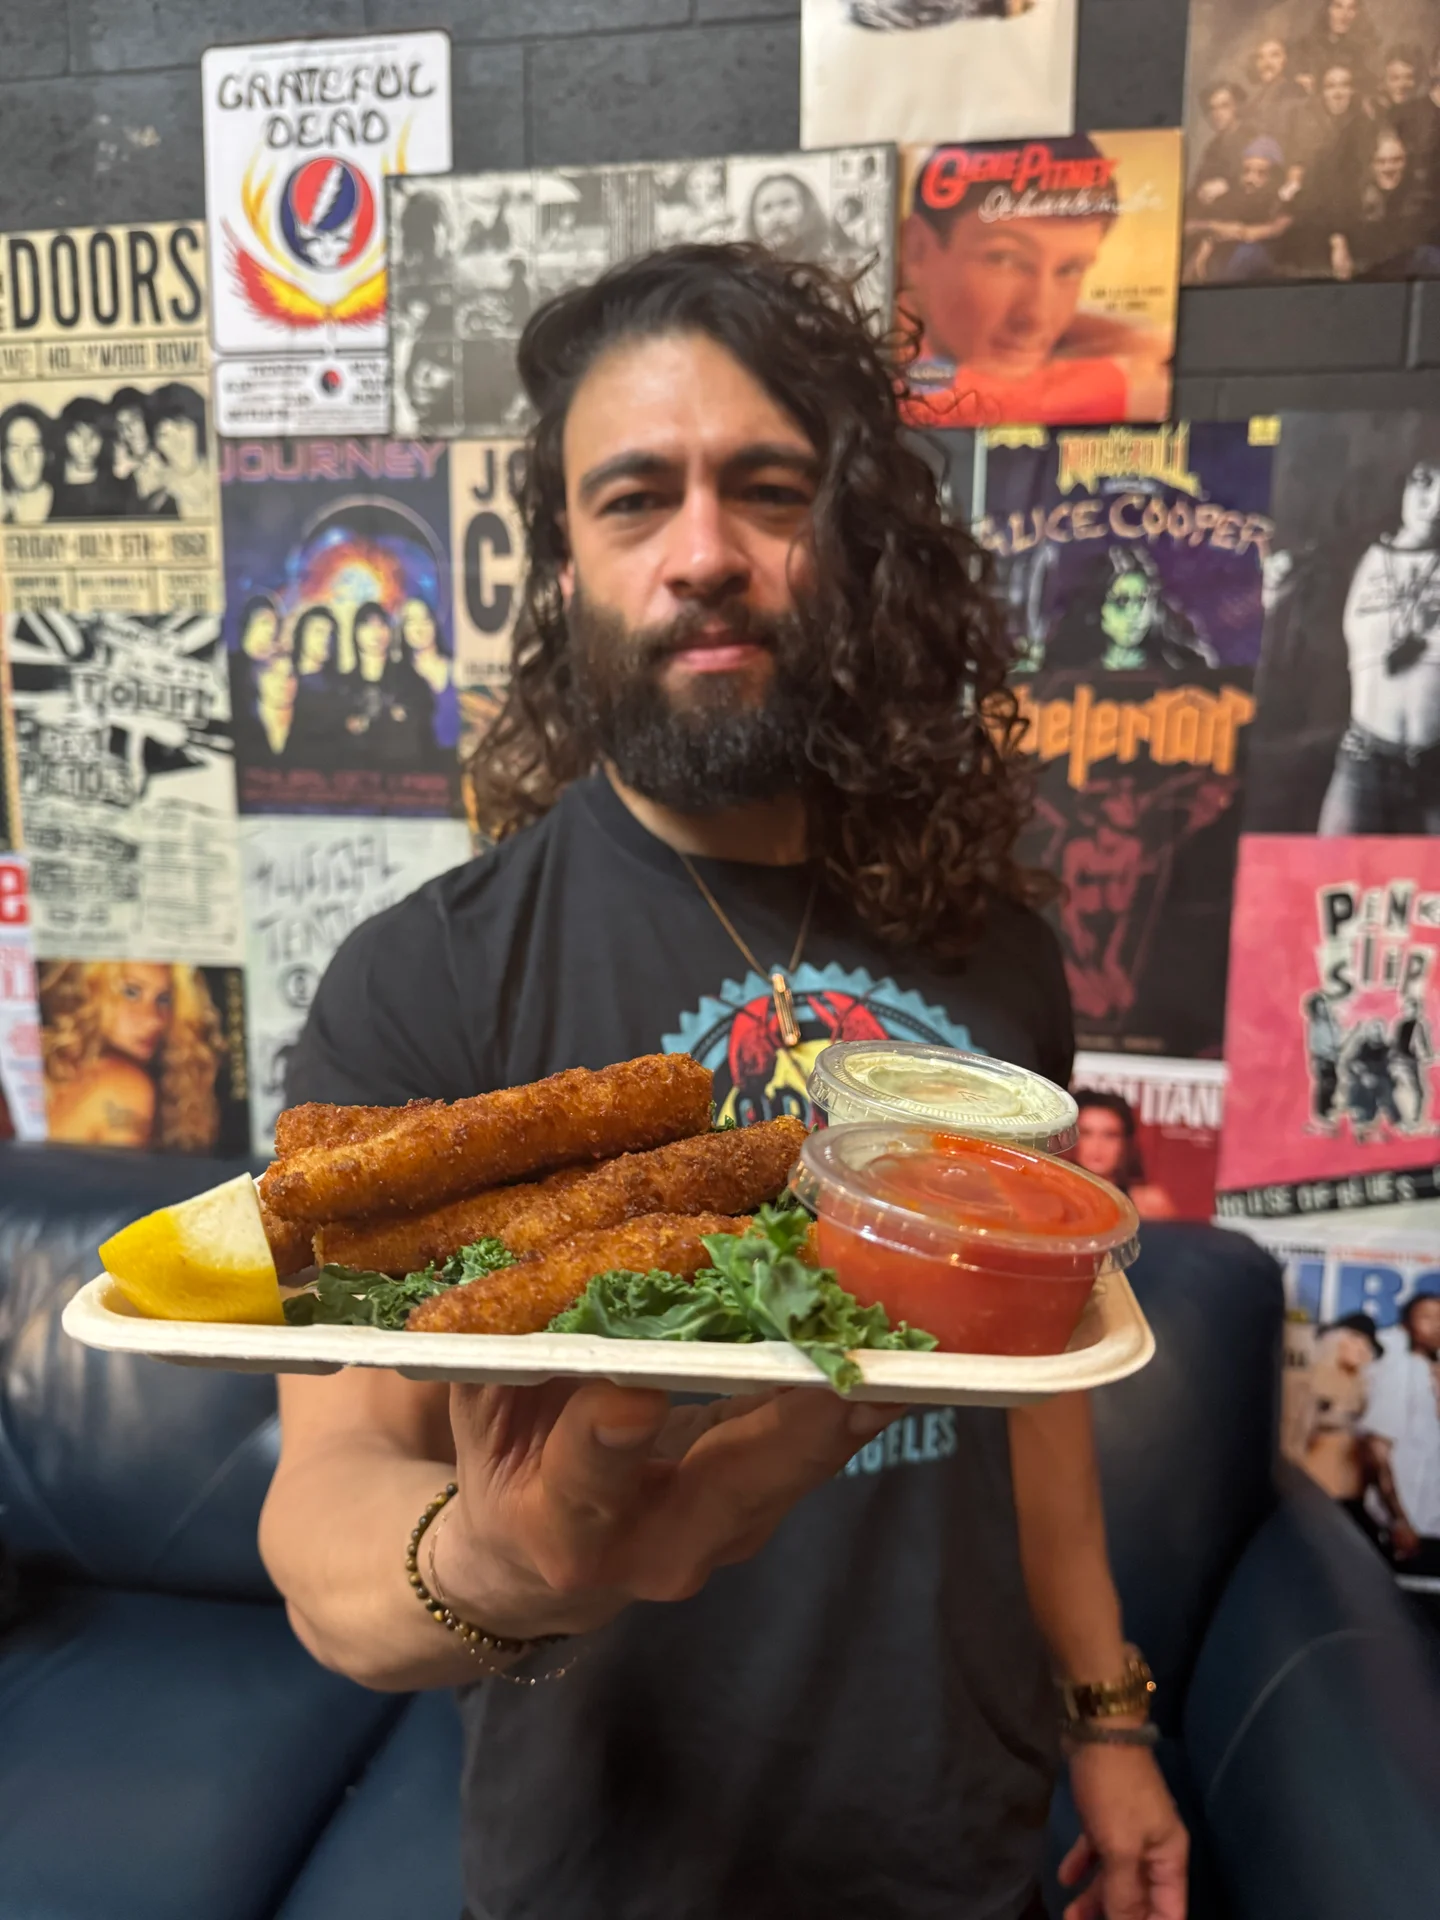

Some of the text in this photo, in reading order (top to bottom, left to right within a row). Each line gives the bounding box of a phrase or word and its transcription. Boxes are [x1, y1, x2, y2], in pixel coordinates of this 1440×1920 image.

[217, 62, 437, 110] GRATEFUL
[265, 110, 388, 149] DEAD
[9, 227, 202, 330] DOORS
[219, 438, 448, 485] JOURNEY
[1109, 493, 1276, 567] COOPER
[845, 1407, 958, 1478] GELES
